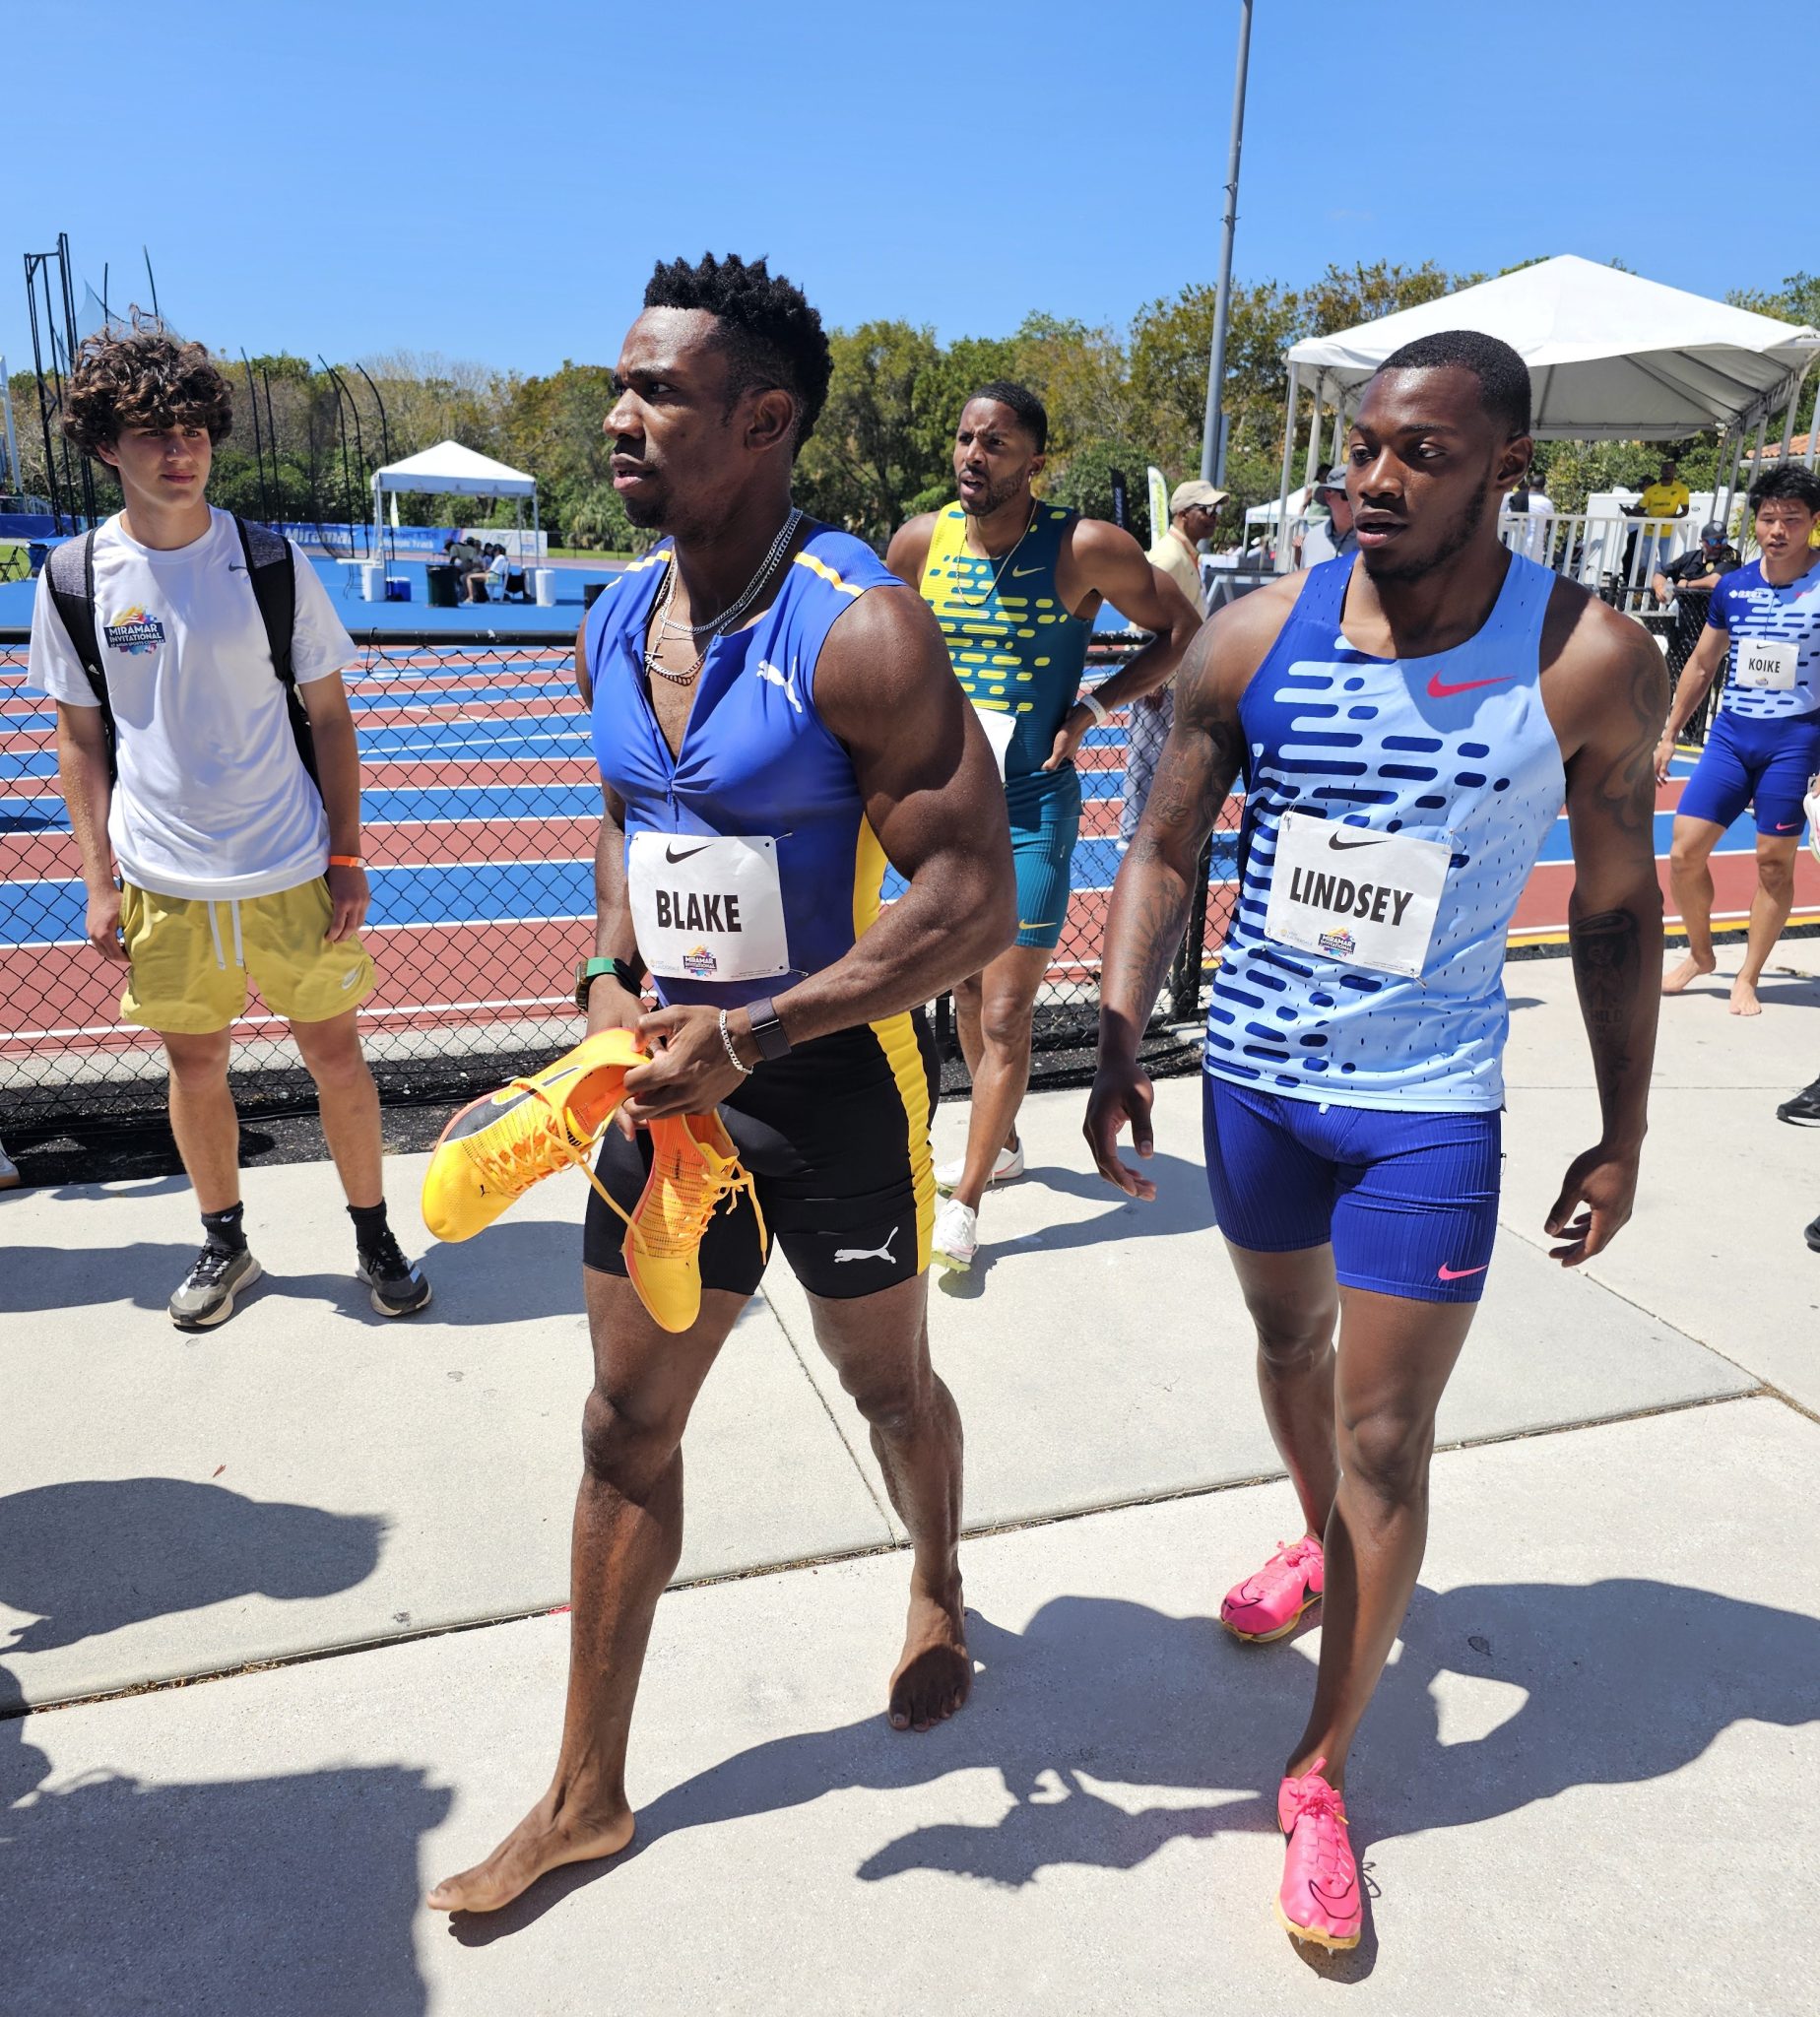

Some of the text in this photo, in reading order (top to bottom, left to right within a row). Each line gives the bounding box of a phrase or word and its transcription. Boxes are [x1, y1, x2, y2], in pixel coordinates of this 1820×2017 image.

[109, 623, 158, 636] MIRAMAR
[109, 632, 162, 643] INVITATIONAL
[1748, 658, 1781, 674] KOIKE
[1289, 867, 1413, 927] LINDSEY
[656, 889, 743, 932] BLAKE
